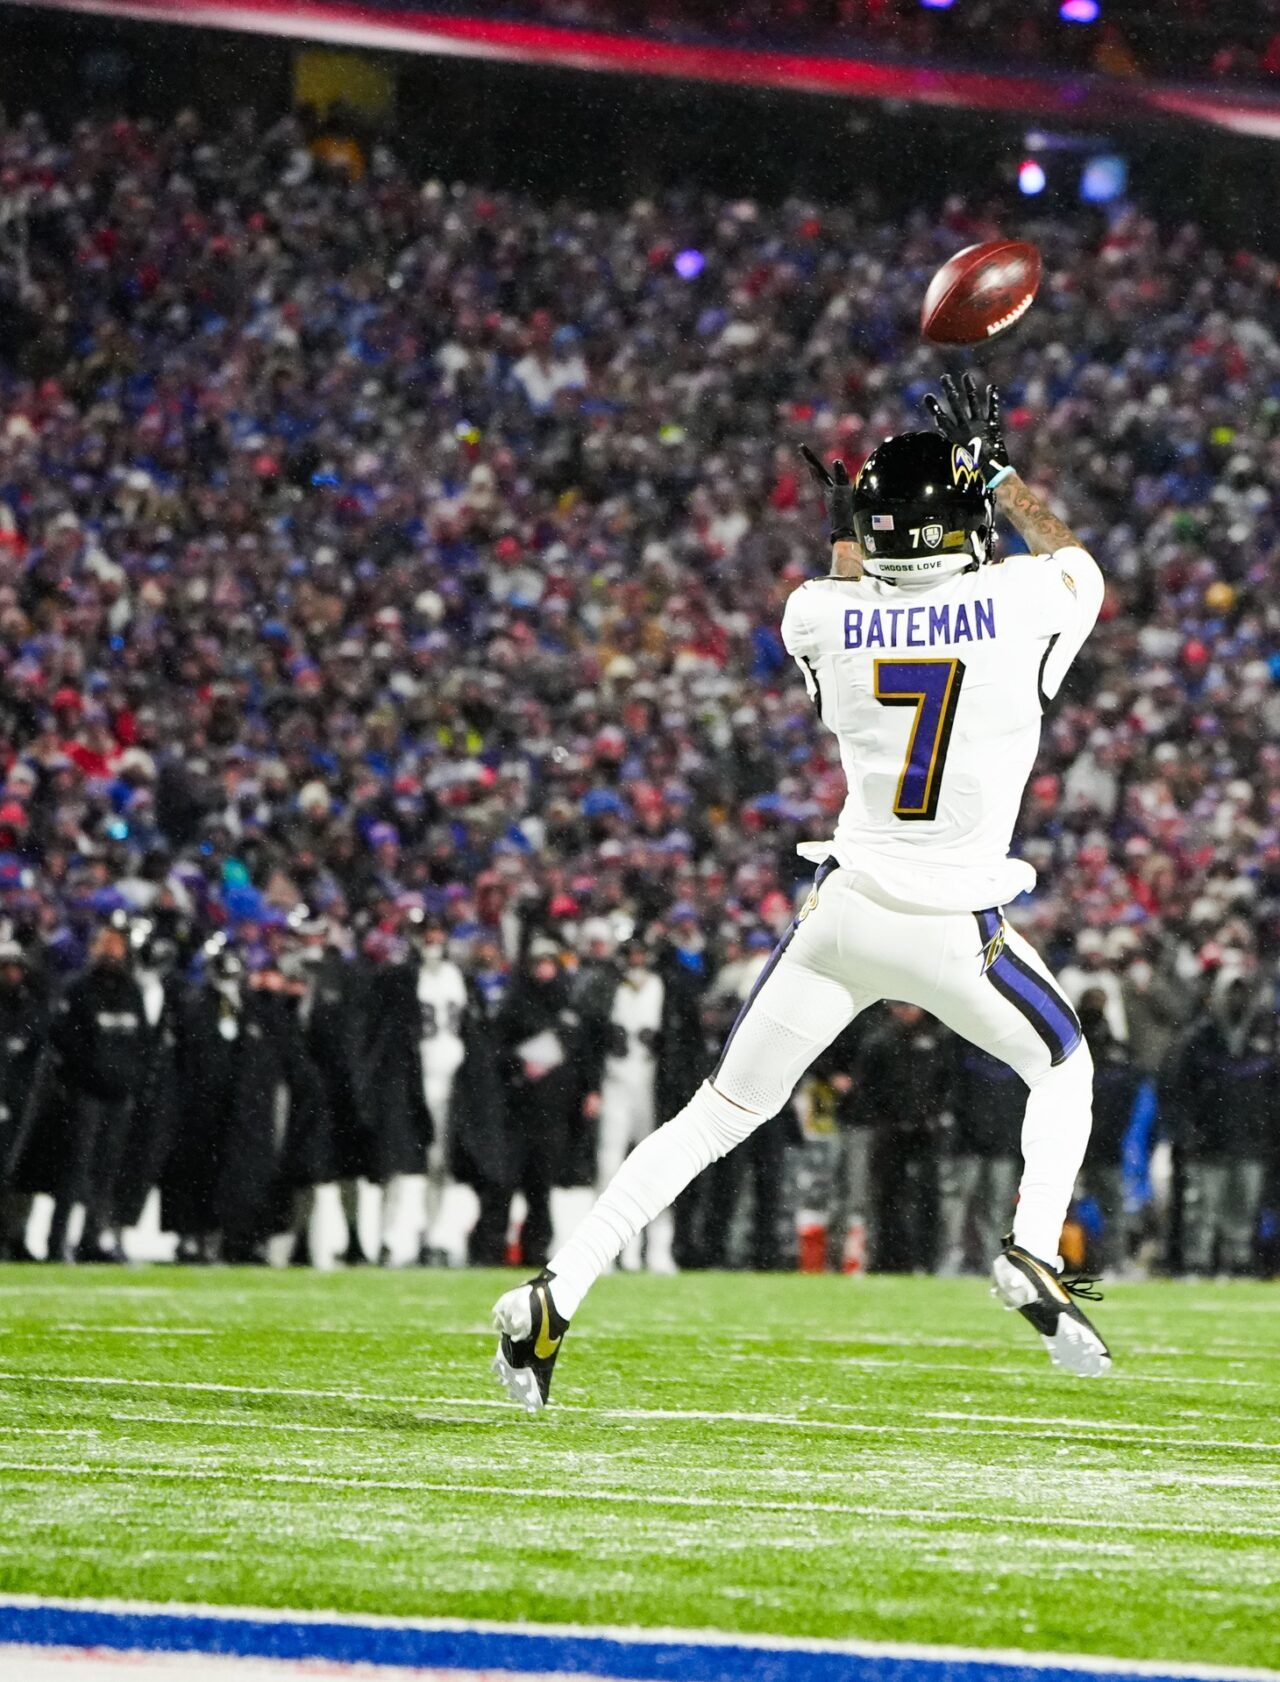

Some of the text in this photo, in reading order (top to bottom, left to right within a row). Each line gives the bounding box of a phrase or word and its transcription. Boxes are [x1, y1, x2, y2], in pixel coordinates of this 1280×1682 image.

[908, 528, 920, 548] 7
[879, 560, 942, 572] CHOOSE LOVE
[844, 598, 996, 649] BATEMAN
[873, 658, 967, 821] 7
